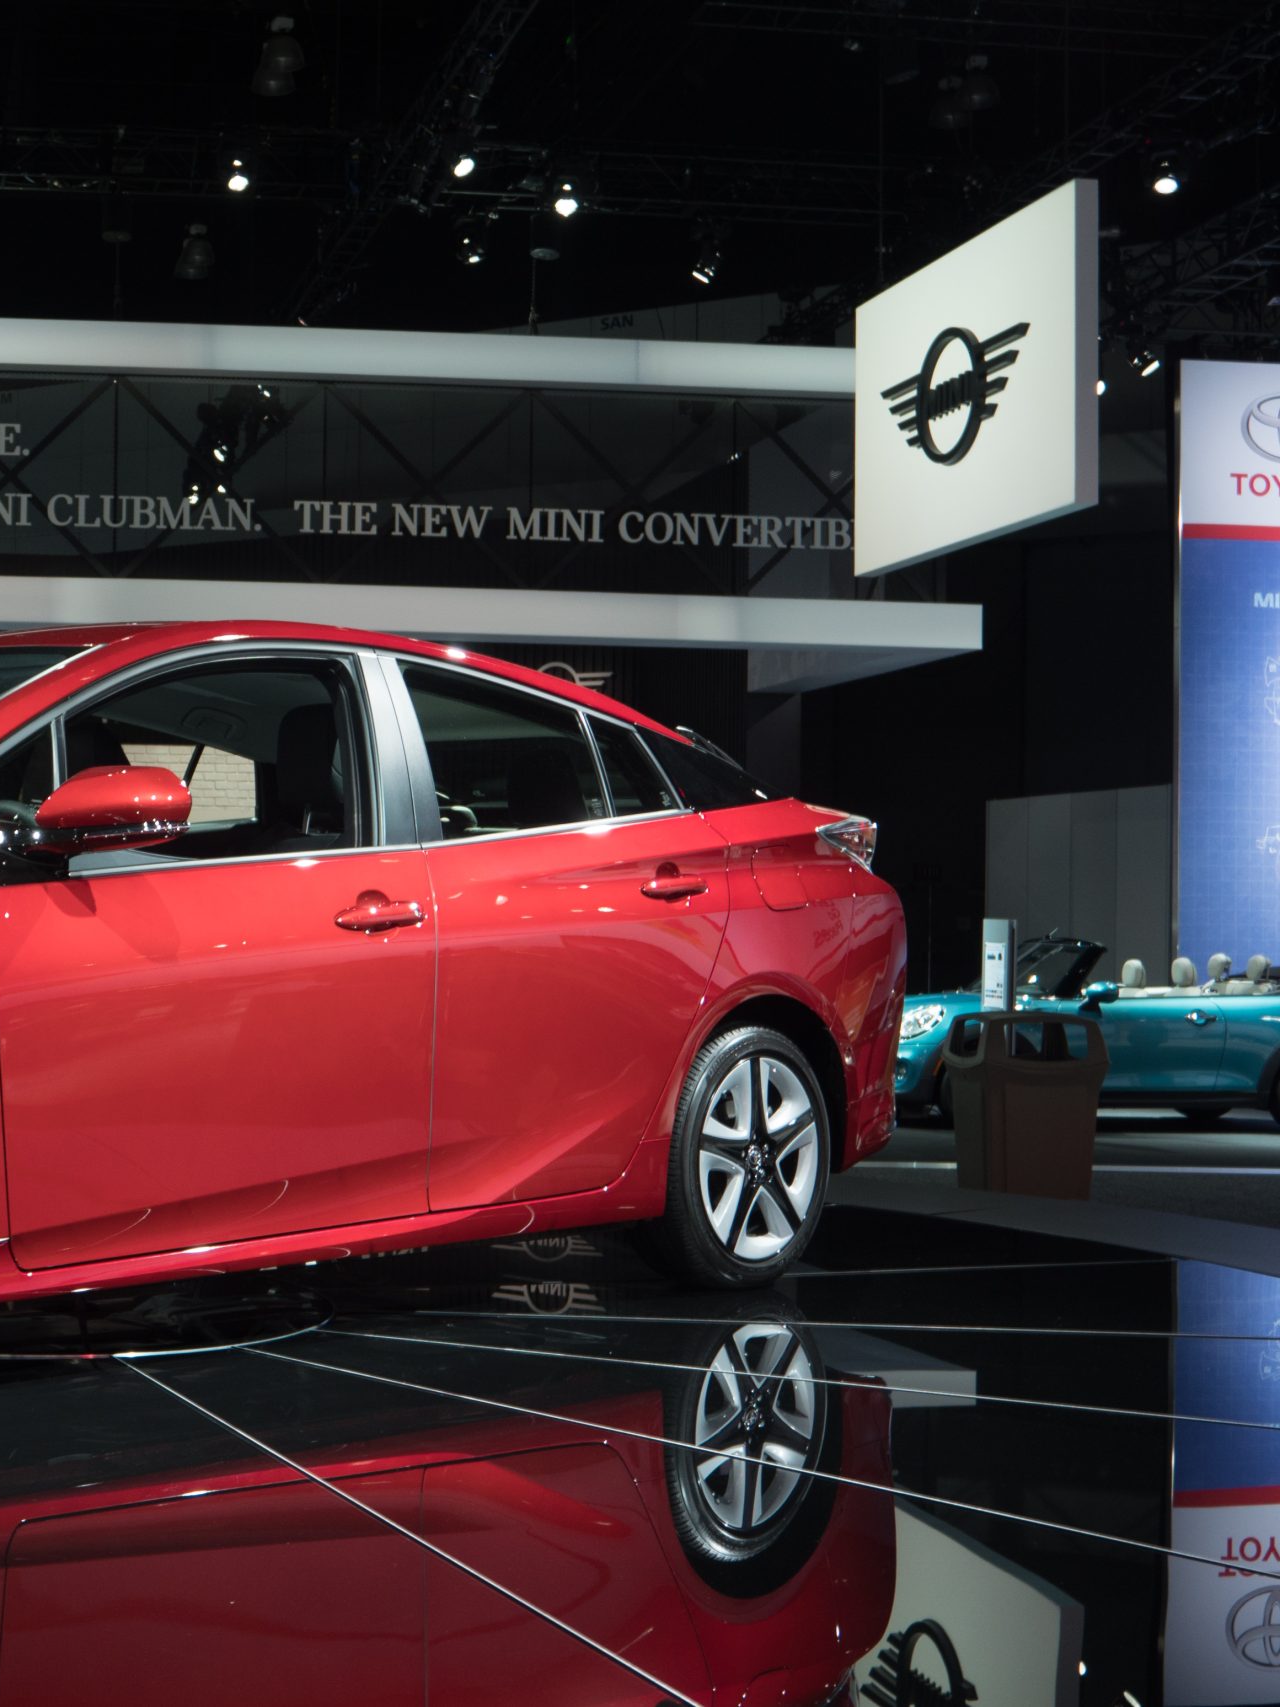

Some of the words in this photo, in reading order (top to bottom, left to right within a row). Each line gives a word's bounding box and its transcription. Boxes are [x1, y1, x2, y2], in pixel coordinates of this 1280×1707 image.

[47, 493, 263, 532] CLUBMAN.
[294, 499, 378, 536] THE
[391, 503, 493, 540] NEW
[506, 506, 605, 543] MINI
